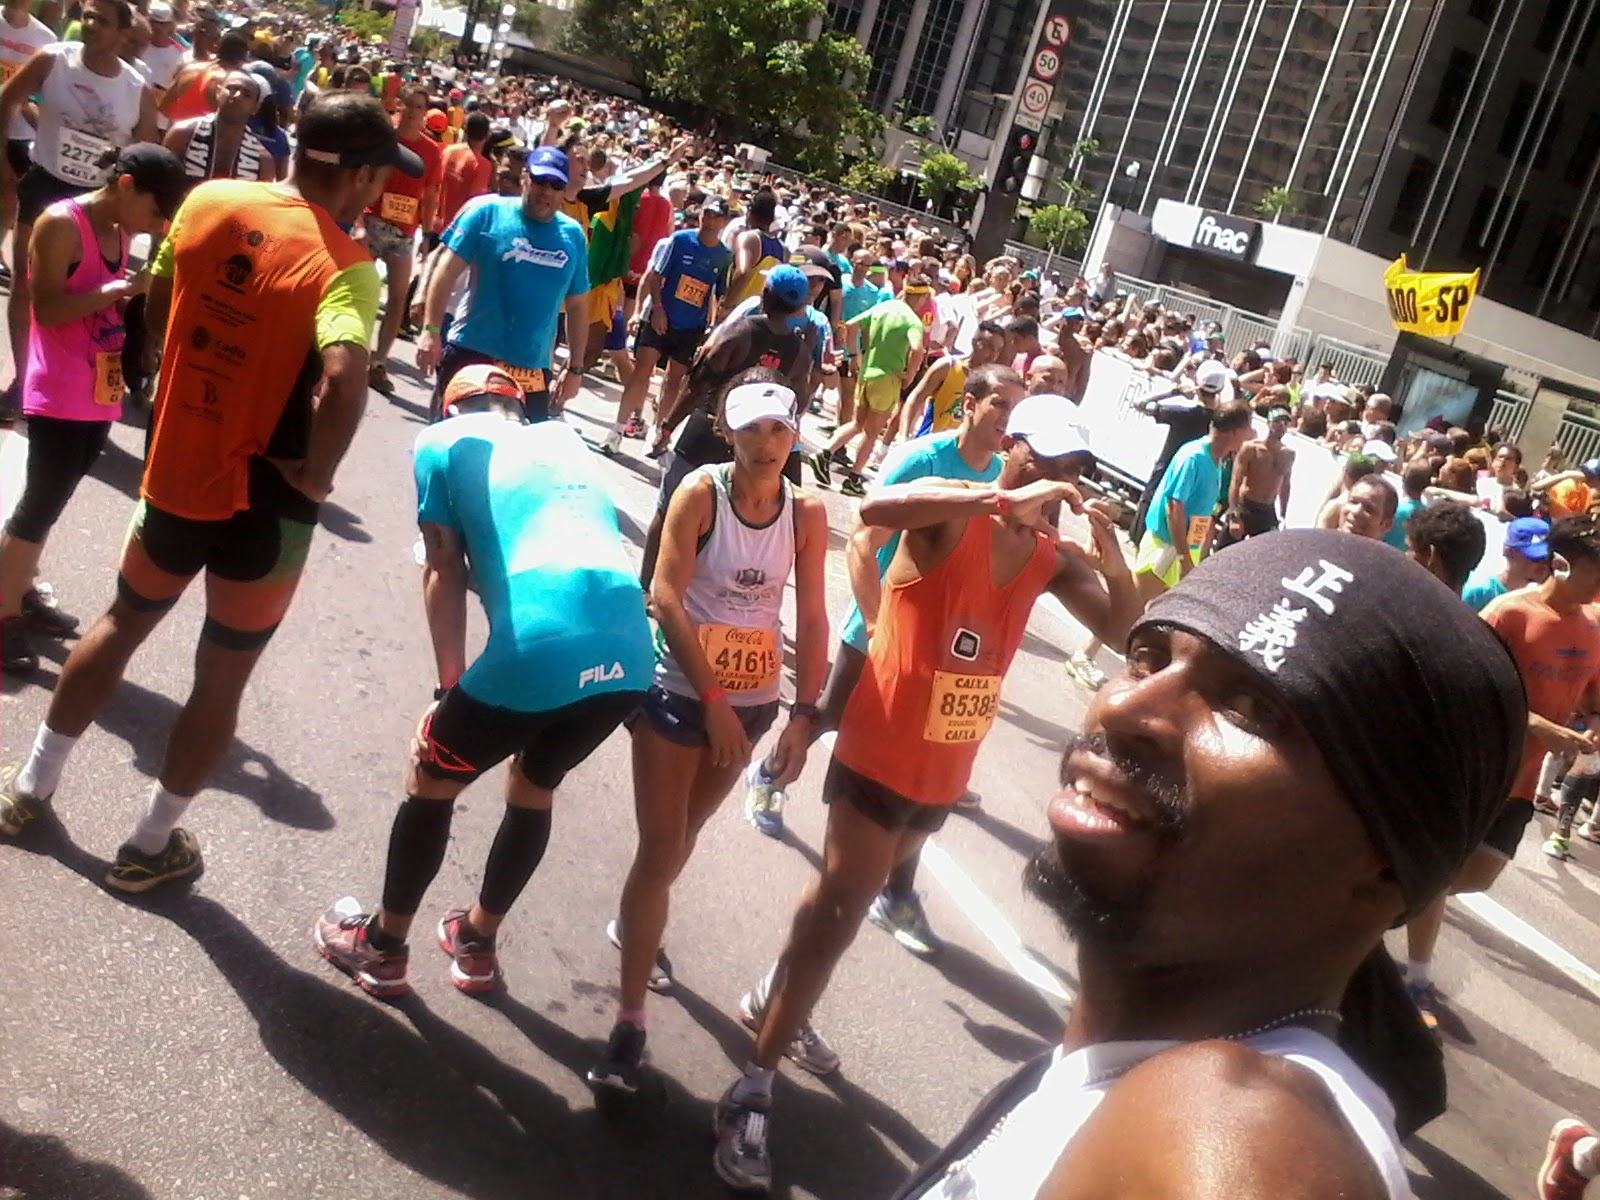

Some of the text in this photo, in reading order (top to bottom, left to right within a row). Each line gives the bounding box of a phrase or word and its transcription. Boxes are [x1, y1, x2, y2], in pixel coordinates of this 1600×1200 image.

[1039, 54, 1056, 71] 50
[1029, 91, 1044, 104] 40
[1196, 215, 1249, 254] fnac
[1435, 284, 1470, 323] SP
[1238, 559, 1354, 672] 正義
[715, 647, 766, 674] 4161
[579, 661, 625, 688] FILA
[719, 680, 760, 690] CAIXA
[955, 677, 989, 689] CAIXA
[945, 729, 976, 740] CAIXA
